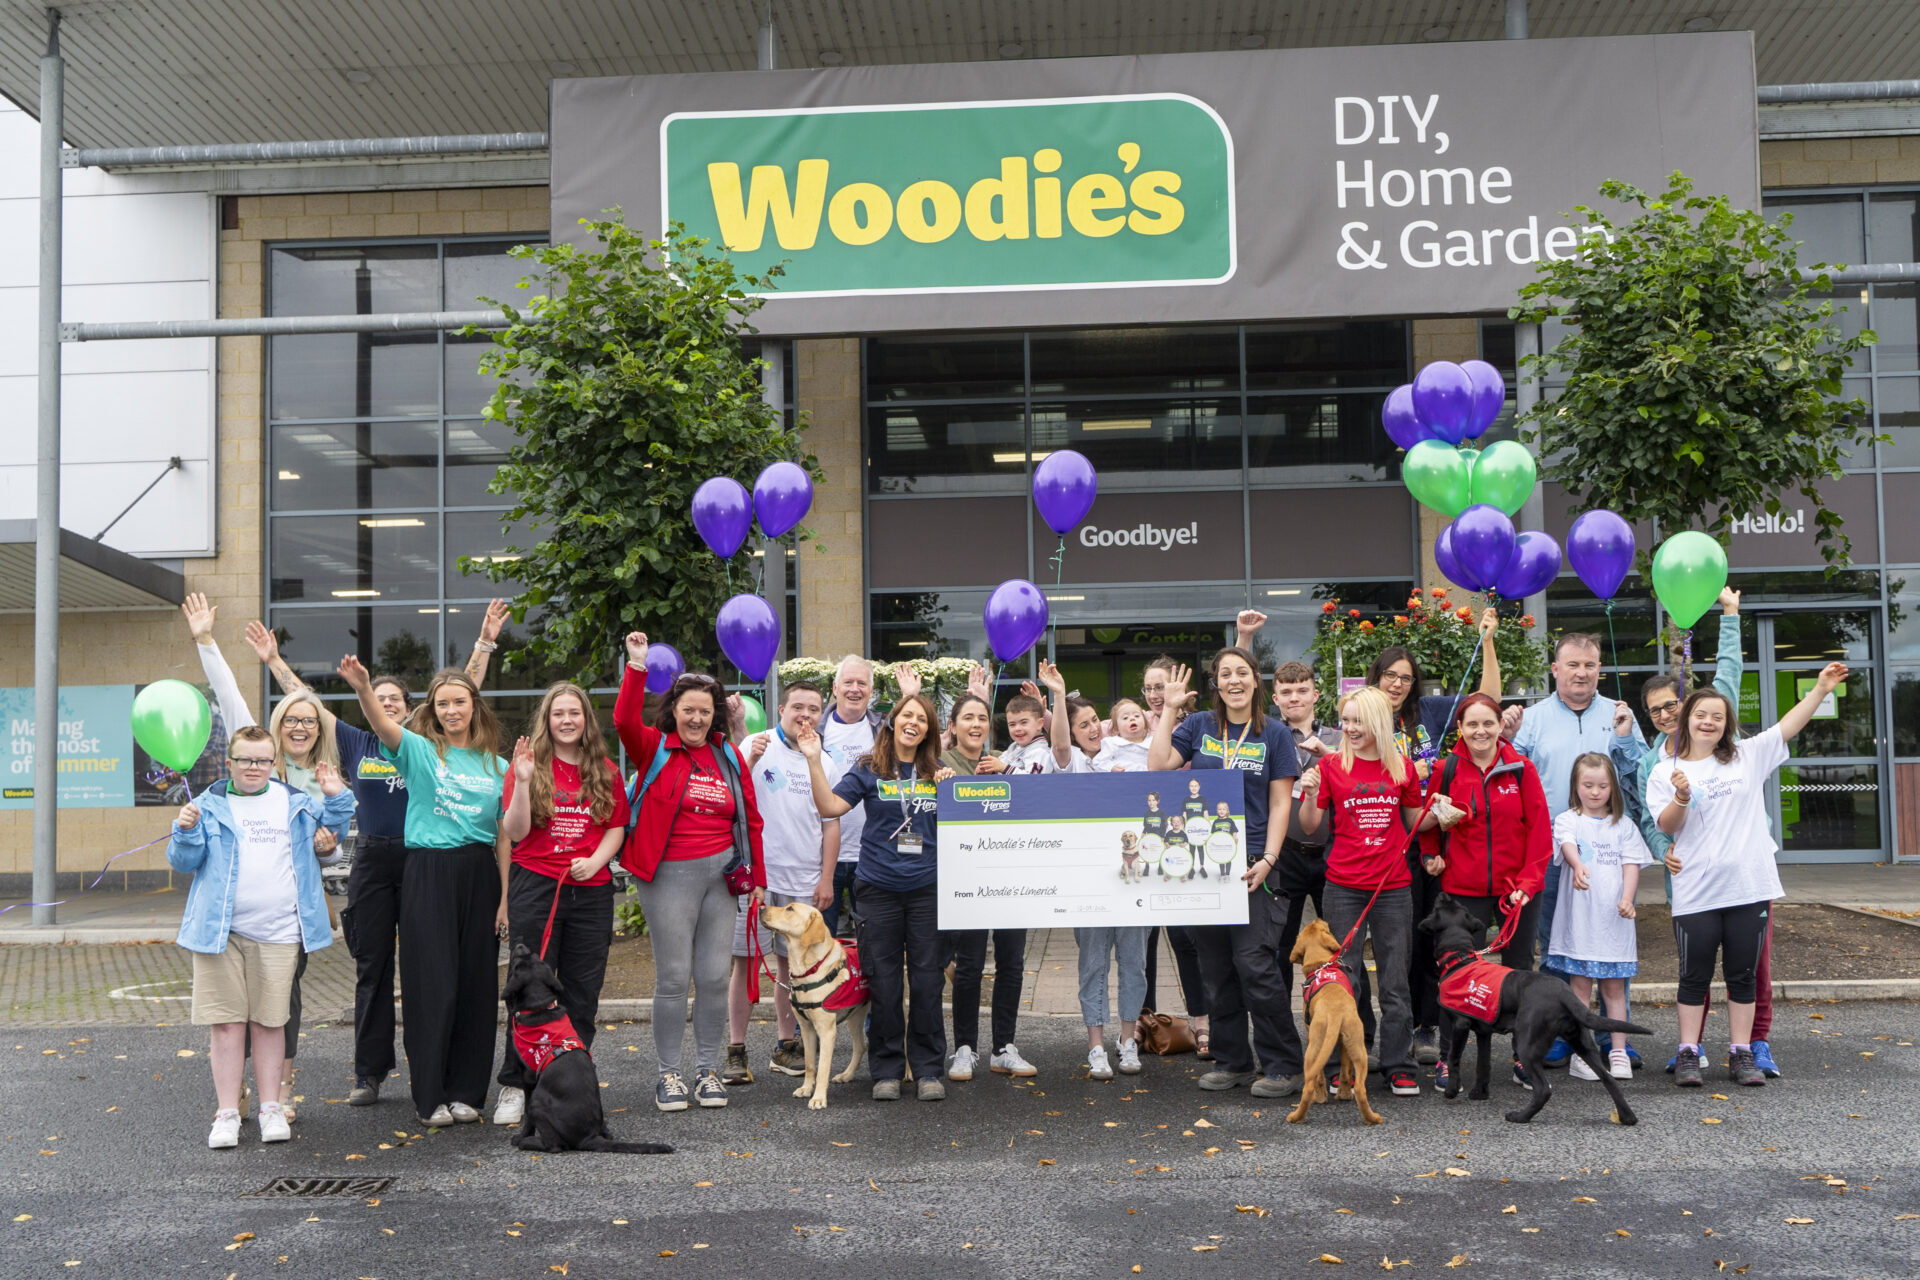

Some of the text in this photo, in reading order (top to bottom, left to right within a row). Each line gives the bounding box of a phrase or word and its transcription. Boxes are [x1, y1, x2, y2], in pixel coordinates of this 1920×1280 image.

[1335, 94, 1450, 155] DIY,
[1336, 160, 1512, 208] Home
[708, 142, 1185, 252] Woodie's
[1336, 221, 1388, 270] &
[1730, 509, 1805, 534] Hello!
[1079, 521, 1199, 551] Goodbye!
[11, 755, 120, 774] of mmer
[1231, 757, 1264, 770] Heroes
[785, 770, 806, 780] Down
[788, 786, 811, 796] Ireland
[957, 786, 1006, 798] Woodie's
[1708, 787, 1732, 801] Ireland
[982, 798, 1011, 813] Heroes
[242, 819, 269, 827] Down
[551, 825, 586, 833] CHILDREN
[249, 836, 277, 844] Ireland
[959, 837, 1064, 852] Pay Woodie's Heroes
[1591, 841, 1611, 849] Down
[954, 884, 1059, 898] From Woodie's Limerick
[1135, 898, 1144, 908] €
